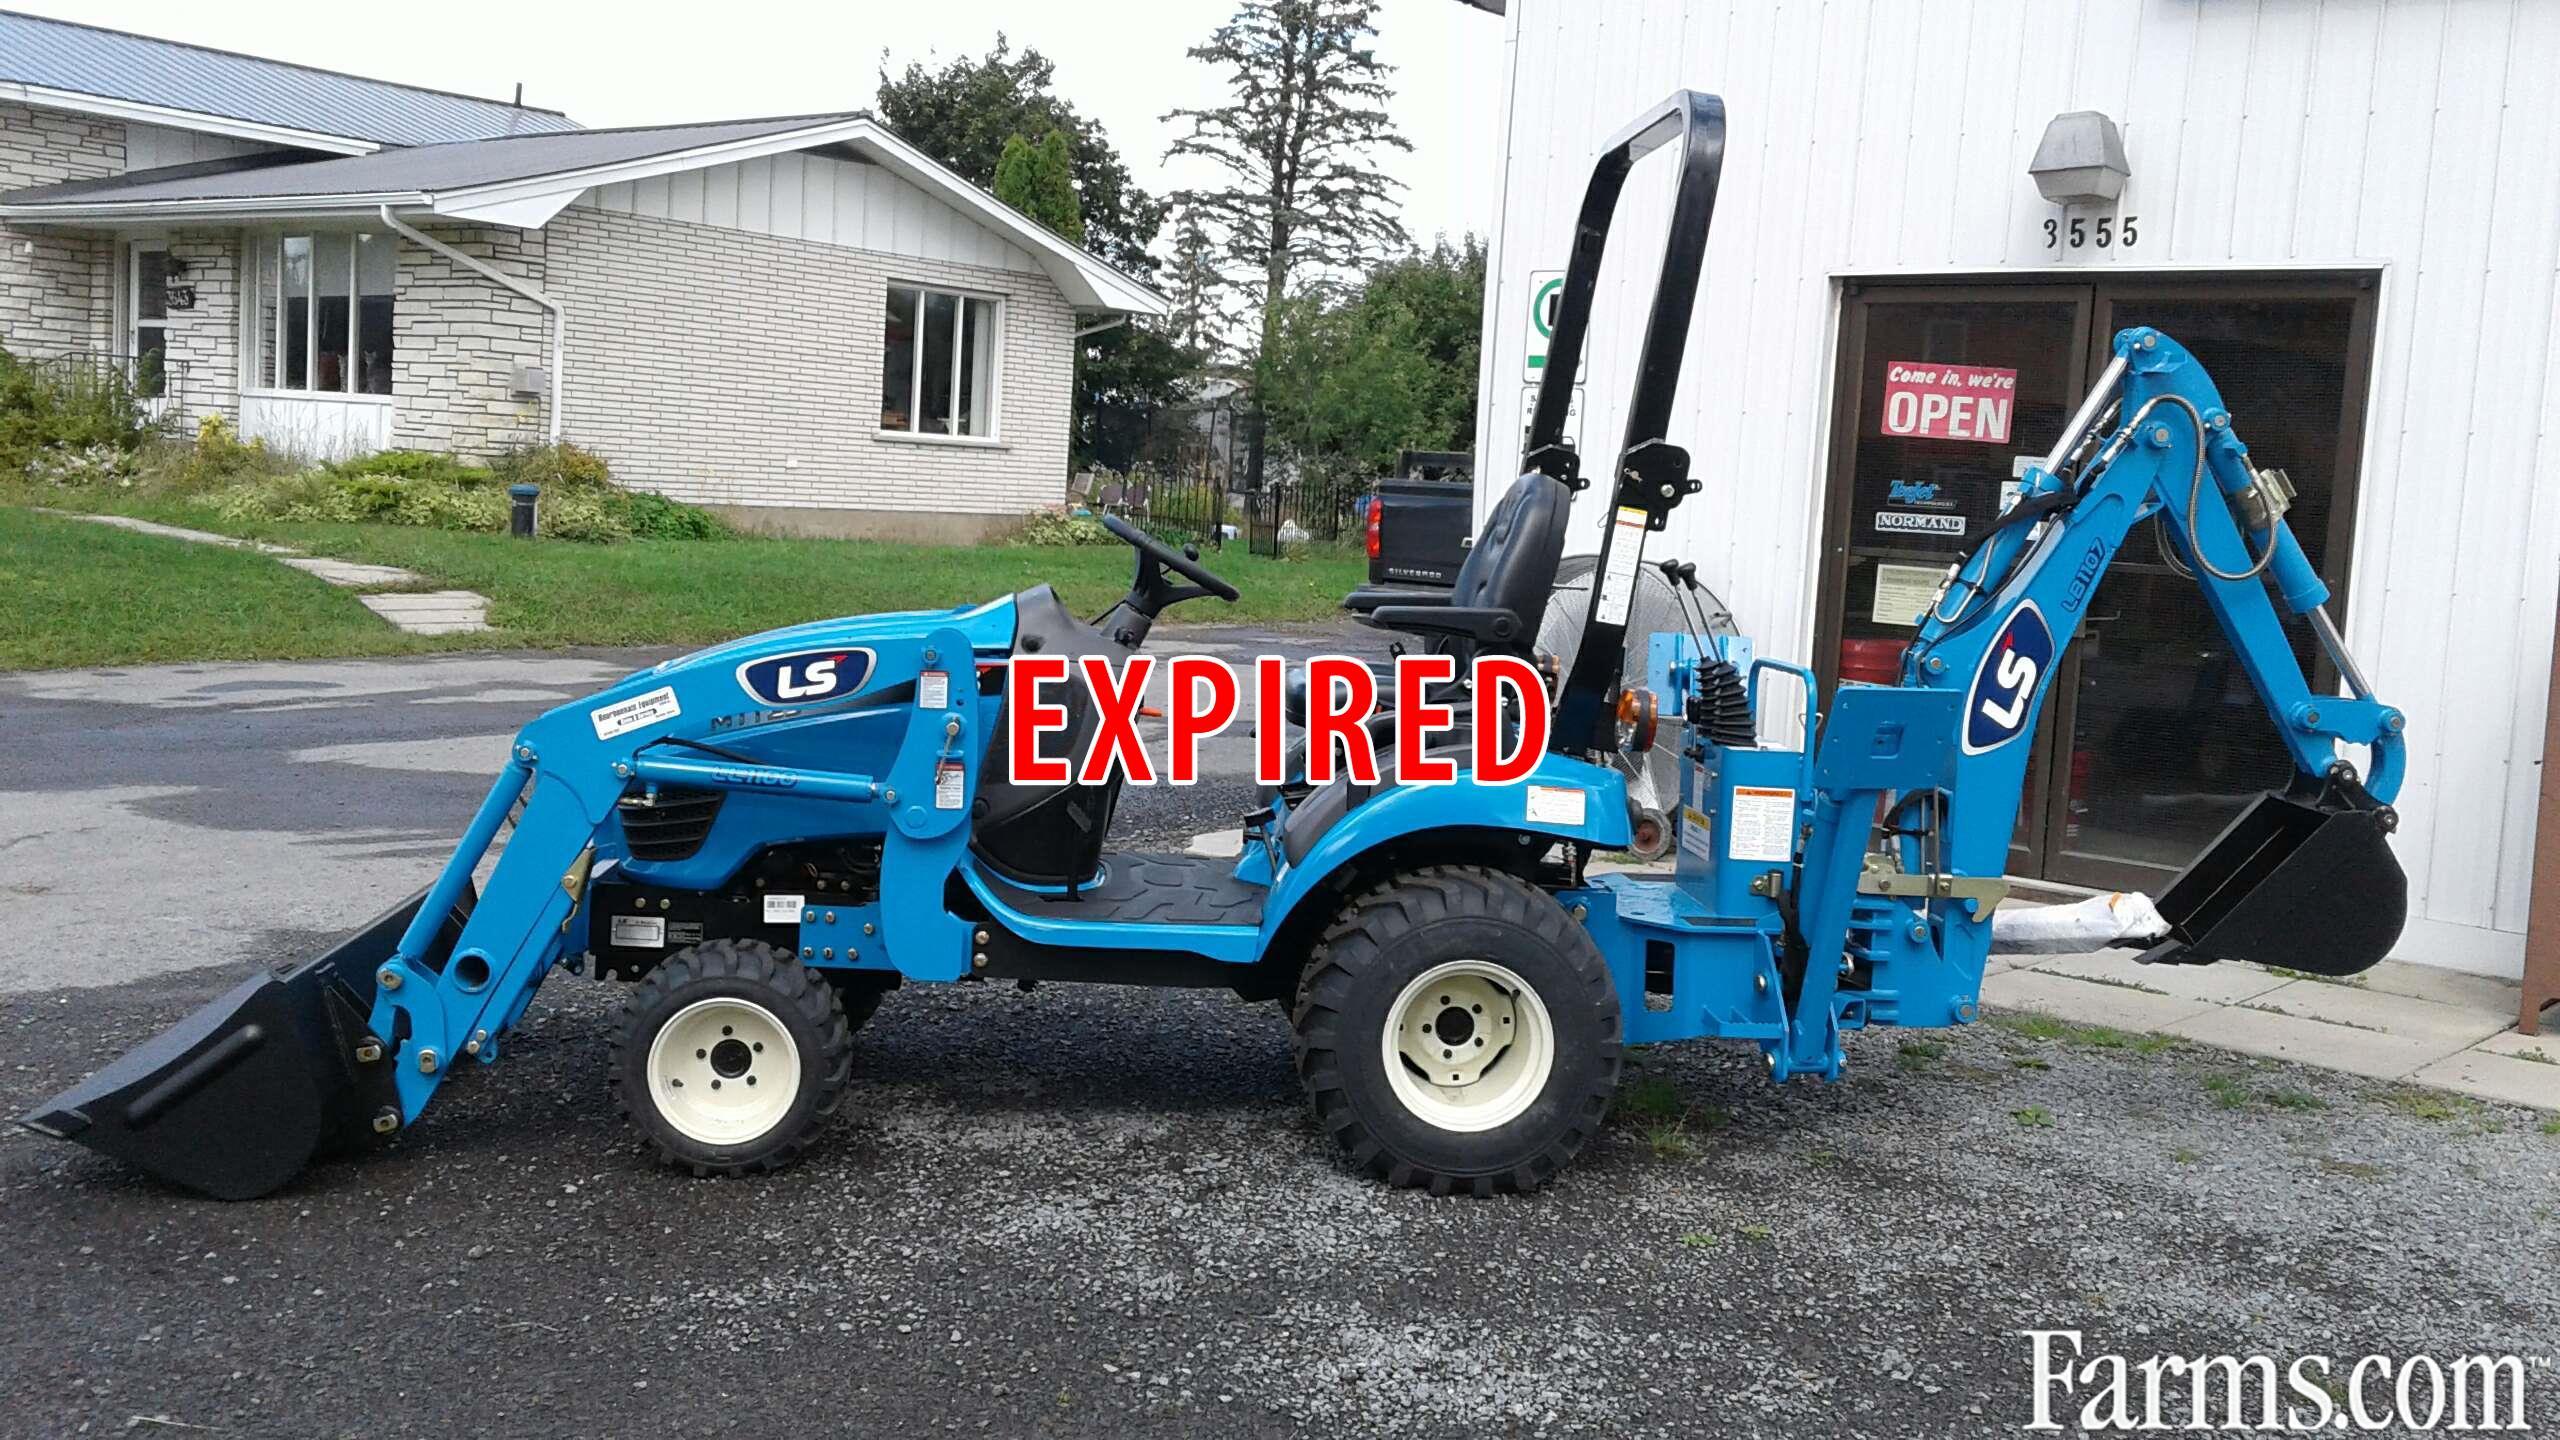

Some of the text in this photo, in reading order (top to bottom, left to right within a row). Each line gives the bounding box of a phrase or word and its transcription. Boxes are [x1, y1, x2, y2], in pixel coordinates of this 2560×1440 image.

[2043, 216, 2138, 249] 3555
[1889, 366, 1937, 384] Come
[1967, 373, 2016, 390] we're
[1888, 391, 2008, 440] OPEN
[1880, 515, 1962, 530] NORMAND
[2062, 537, 2107, 613] LB1107
[777, 660, 837, 699] LS
[1982, 648, 2037, 729] LS
